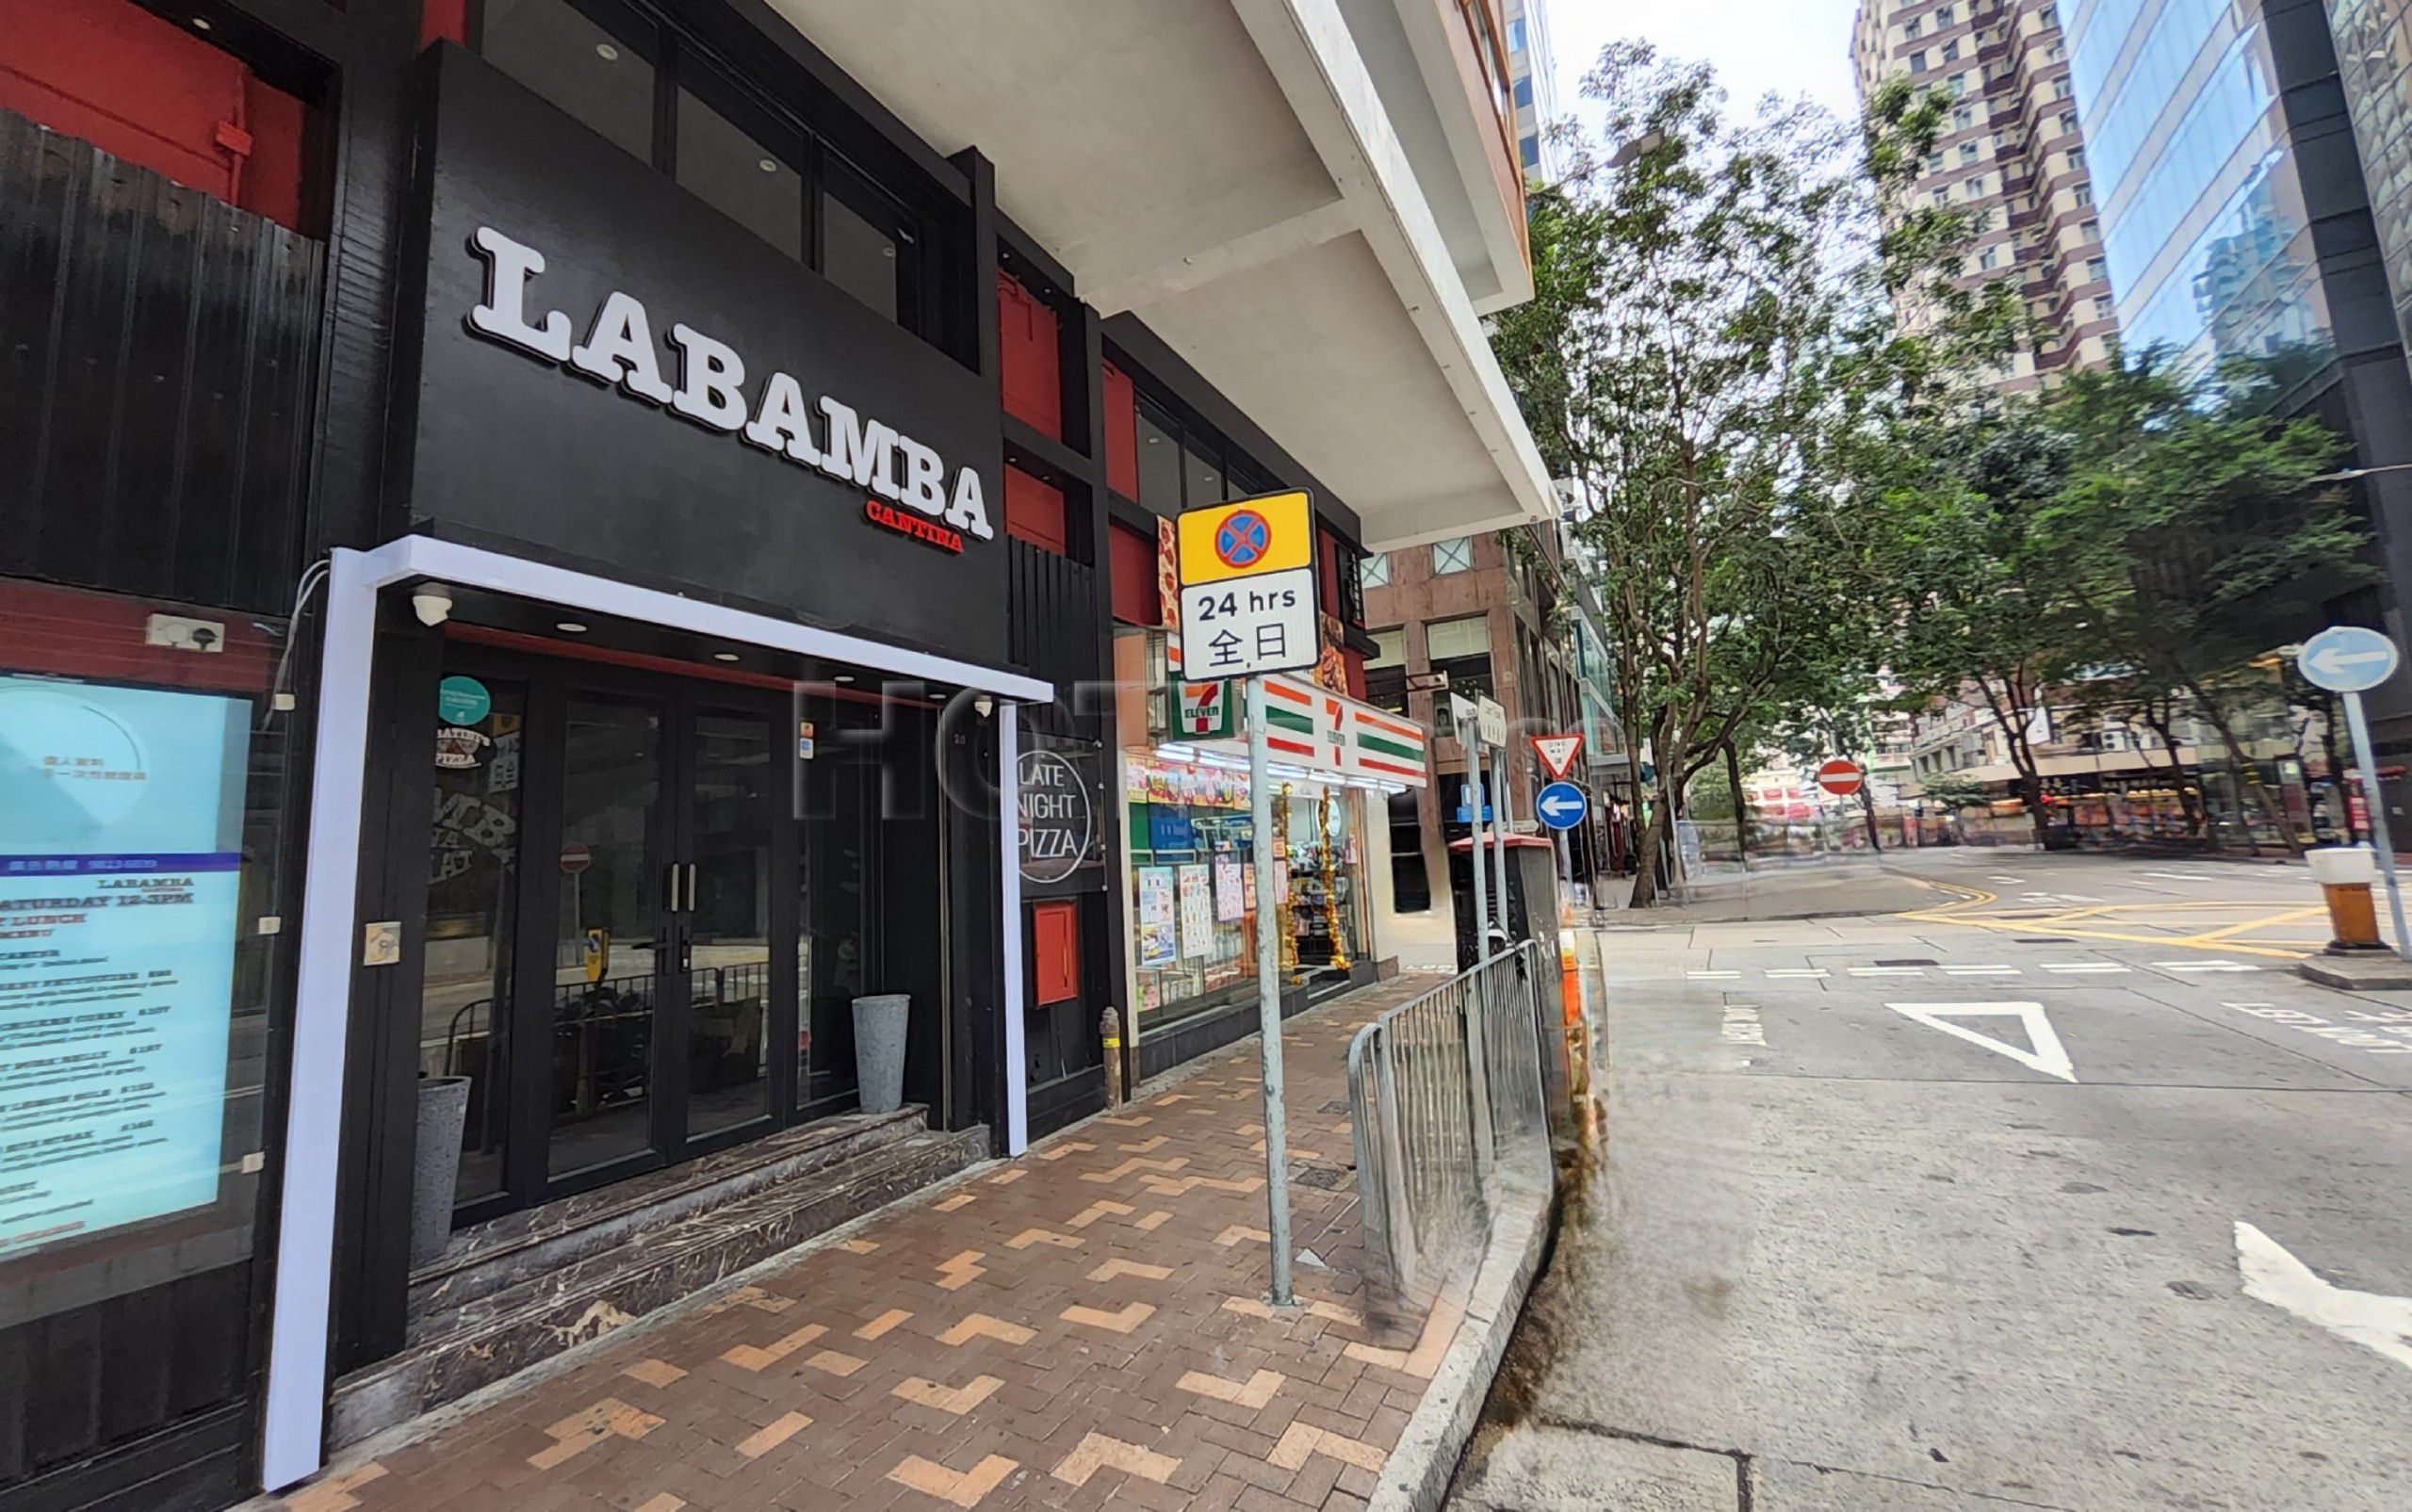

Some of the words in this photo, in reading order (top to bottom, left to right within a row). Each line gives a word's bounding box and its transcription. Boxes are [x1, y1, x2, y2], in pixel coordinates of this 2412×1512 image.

[472, 226, 993, 541] LABAMBA
[866, 500, 964, 554] CANTINA
[1198, 592, 1238, 622] 24
[1249, 589, 1296, 613] hrs
[1208, 622, 1287, 668] 全日
[1019, 761, 1066, 788] LATE
[1017, 793, 1077, 820] NIGHT
[1018, 828, 1079, 858] PIZZA
